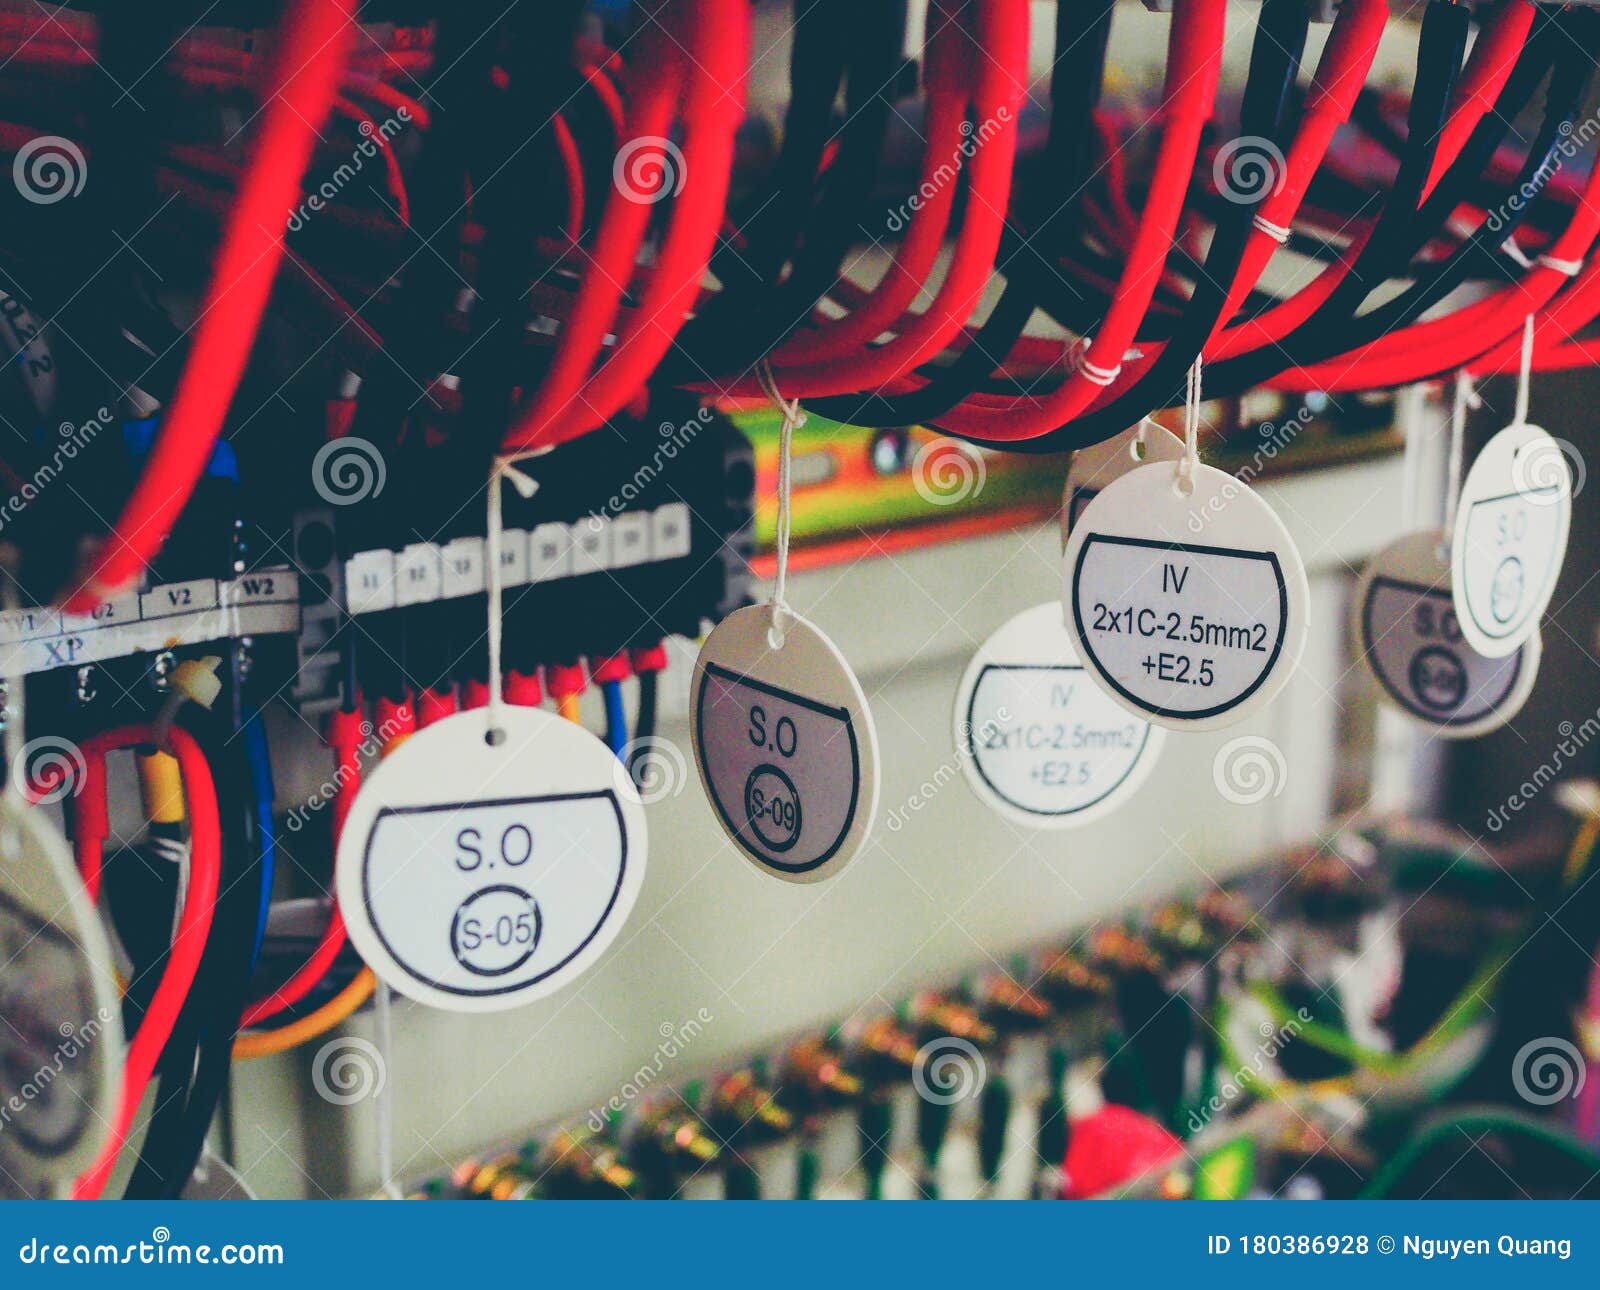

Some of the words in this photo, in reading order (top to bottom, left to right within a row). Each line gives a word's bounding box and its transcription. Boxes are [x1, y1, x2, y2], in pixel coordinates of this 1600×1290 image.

[168, 588, 192, 607] V2
[242, 577, 275, 597] W2
[1162, 563, 1190, 594] IV
[1092, 602, 1268, 652] 2x1C-2.5mm2
[1141, 652, 1215, 687] +E2.5
[1051, 684, 1075, 707] IV
[748, 704, 798, 759] S.O
[984, 722, 1137, 751] 2x1C-2.5mm2
[751, 787, 796, 832] S-09
[455, 823, 533, 871] S.O
[461, 912, 532, 950] S-05
